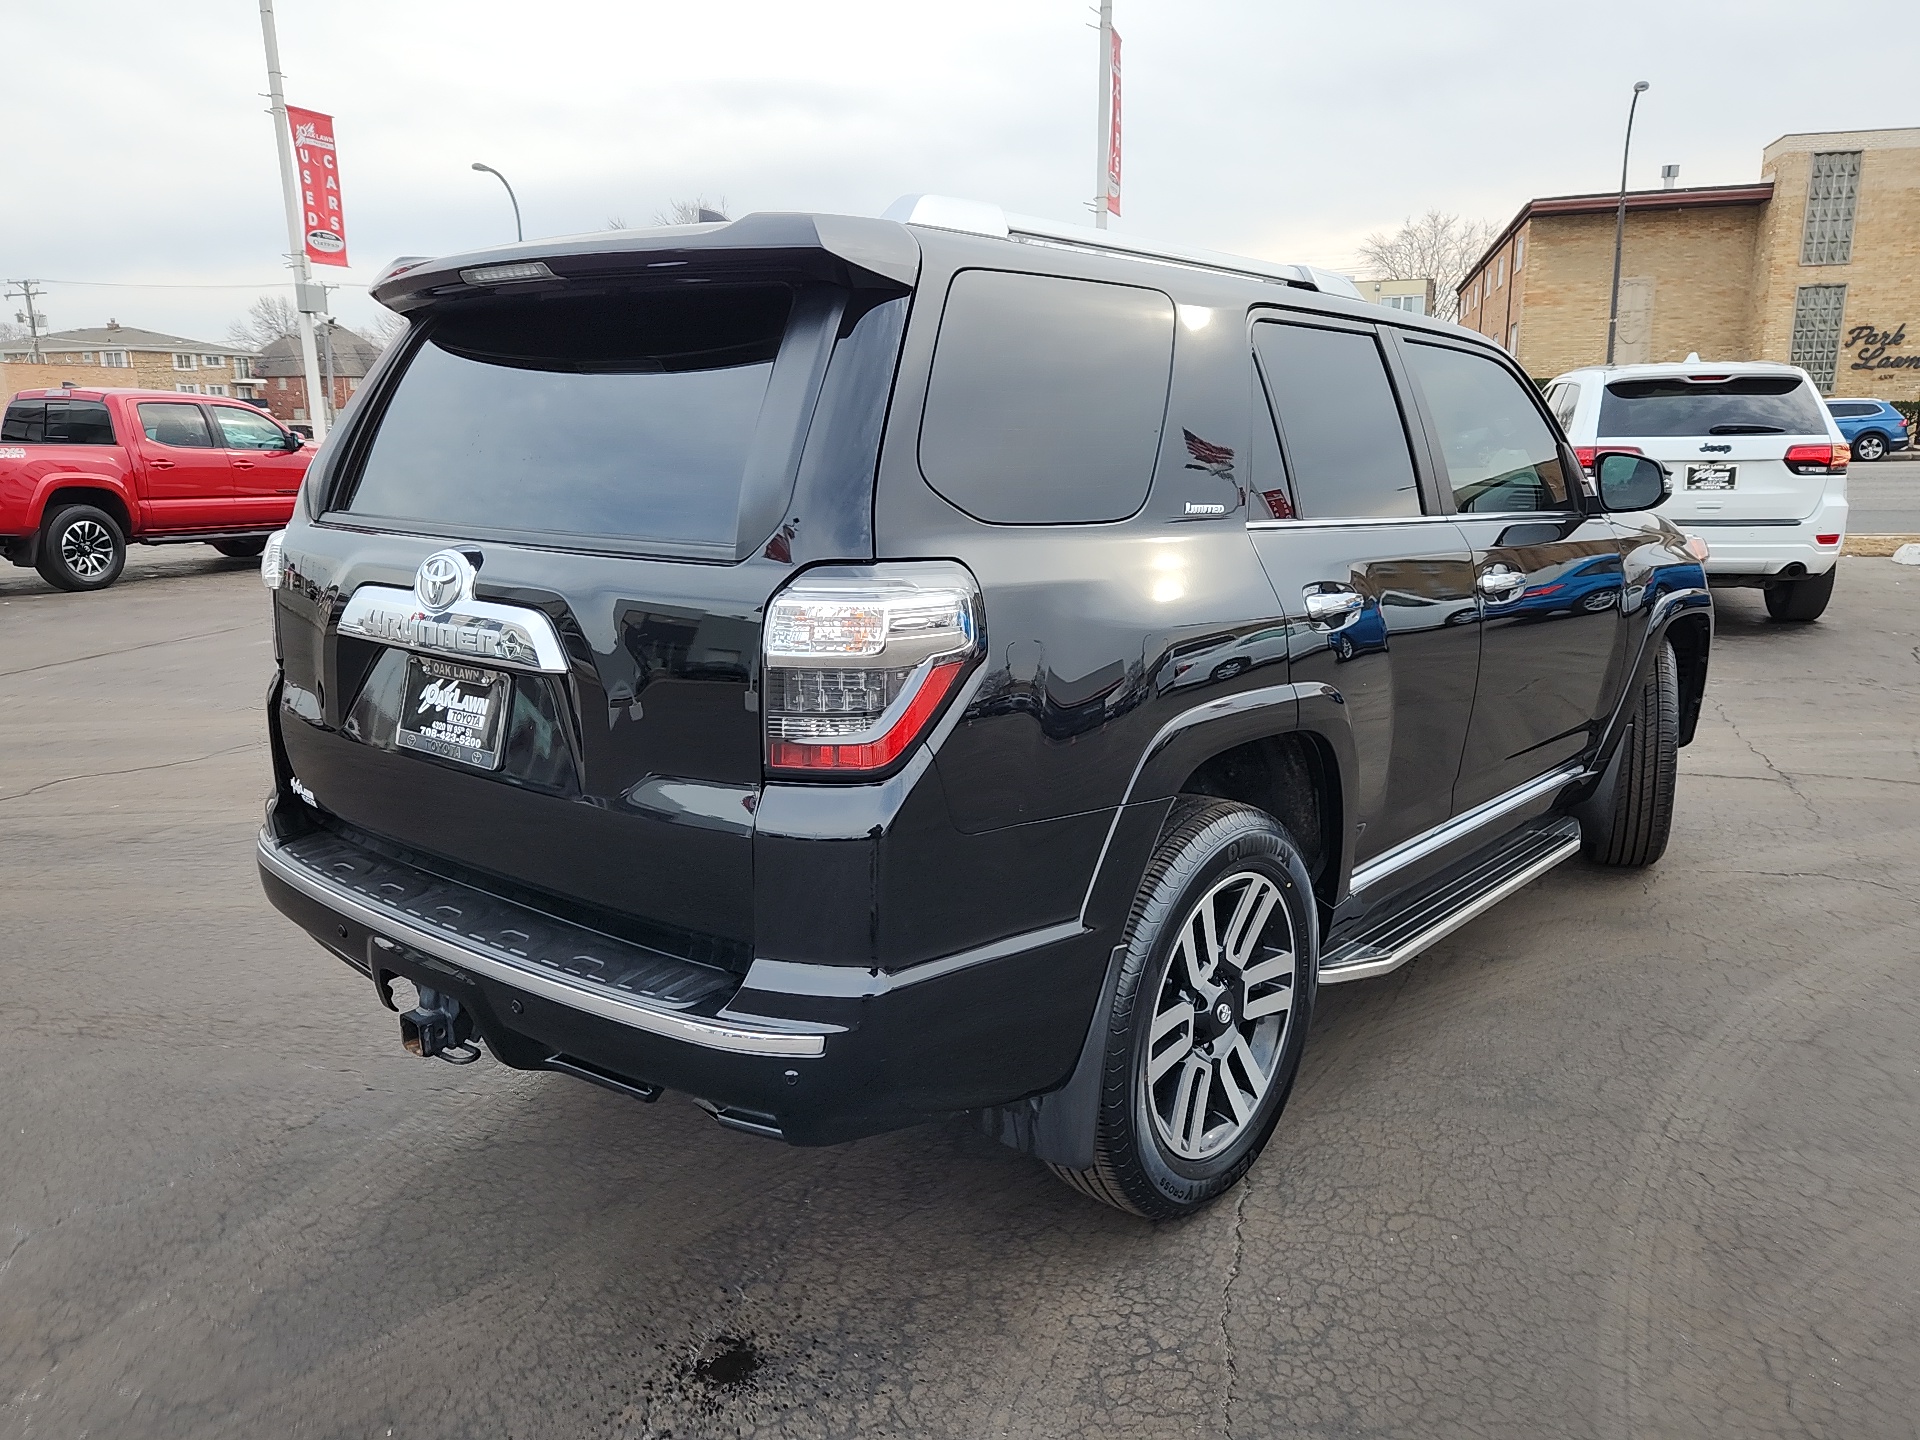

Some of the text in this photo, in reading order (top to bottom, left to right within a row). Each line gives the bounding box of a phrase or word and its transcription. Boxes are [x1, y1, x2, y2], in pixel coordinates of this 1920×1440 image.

[300, 148, 340, 231] USED CARS
[1844, 323, 1907, 348] Park
[1699, 442, 1732, 455] Jeep
[363, 608, 501, 654] 4RUNNER
[433, 663, 480, 680] OAK LAWN
[452, 711, 480, 726] TOYOTA
[420, 726, 482, 748] 708-423-5200
[425, 739, 461, 758] TOYOTA
[1159, 1177, 1185, 1199] CROSS
